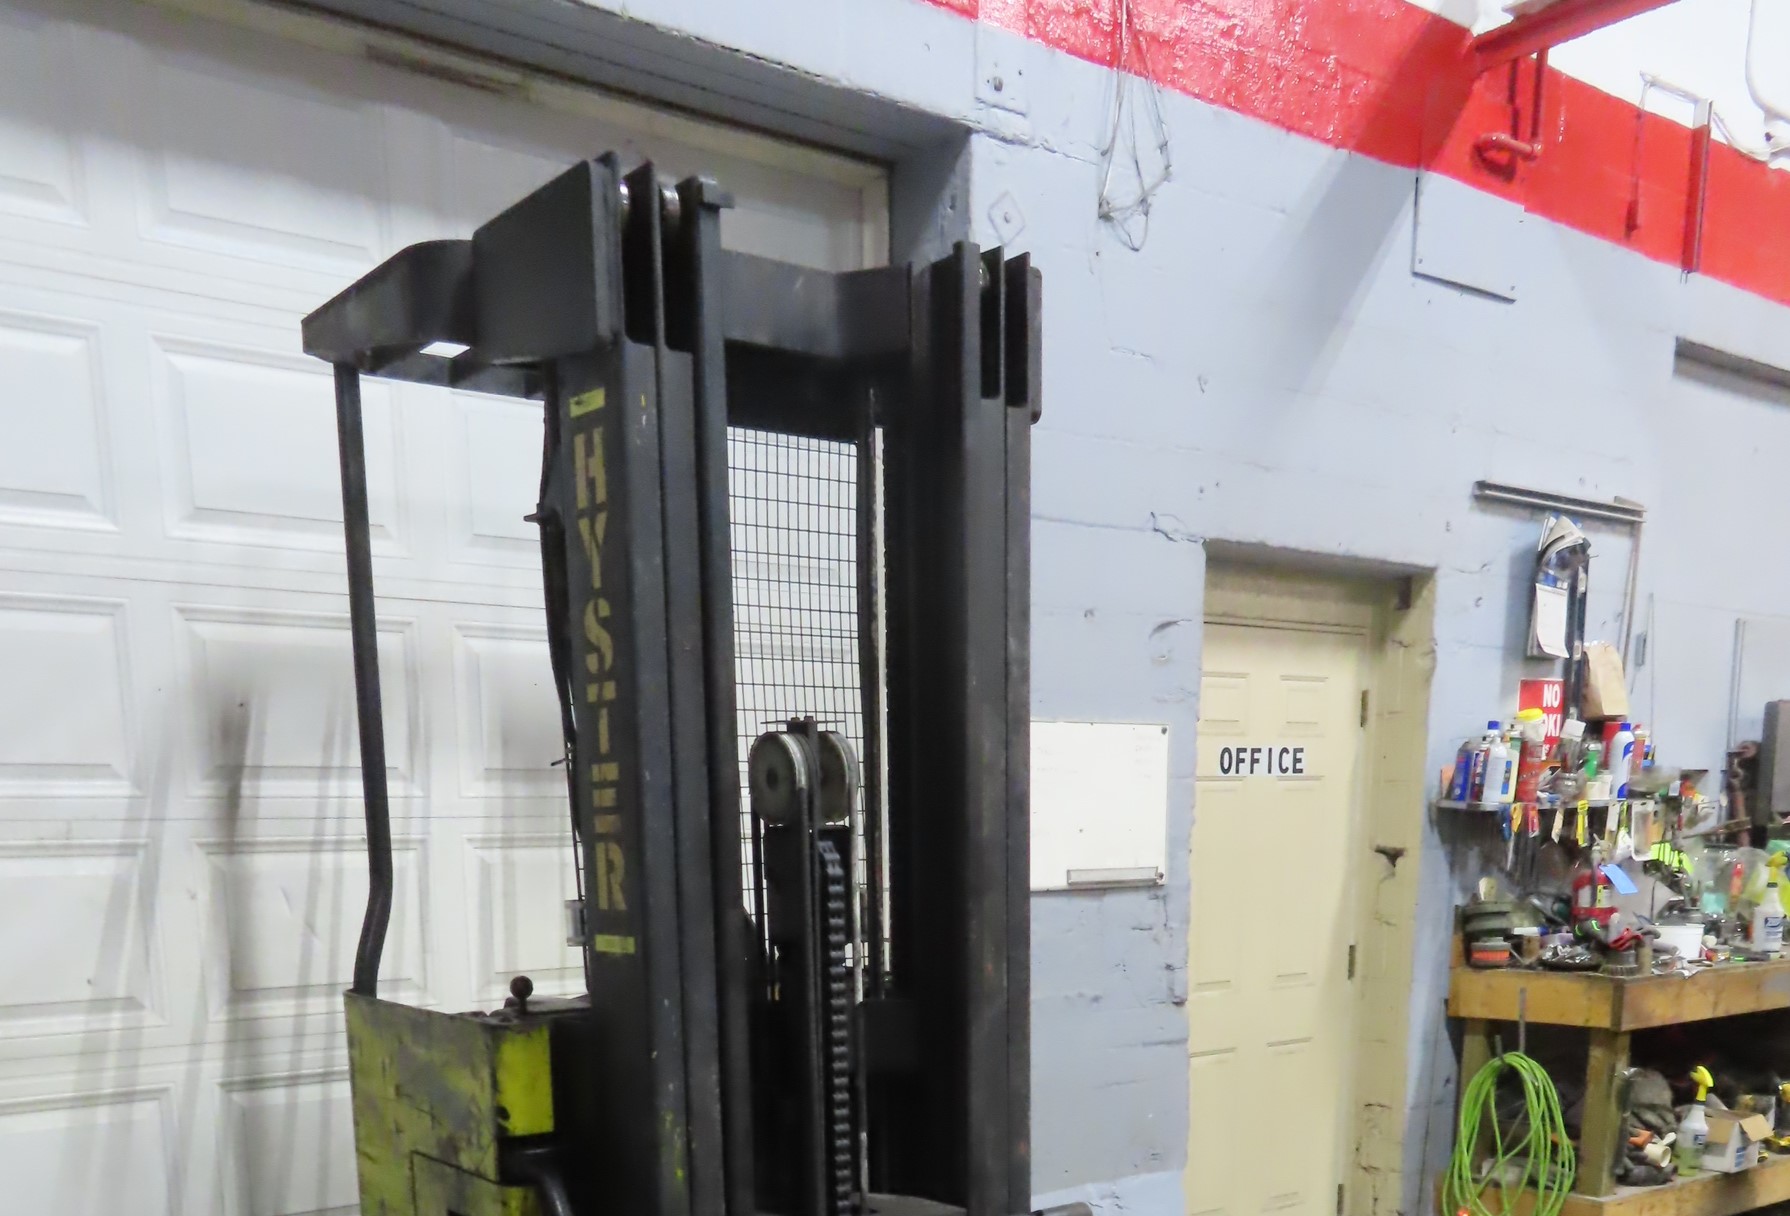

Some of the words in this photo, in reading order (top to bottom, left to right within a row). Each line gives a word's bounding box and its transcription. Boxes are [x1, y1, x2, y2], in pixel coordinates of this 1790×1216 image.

[573, 427, 627, 911] HYSTER
[1542, 683, 1561, 708] NO
[1219, 746, 1305, 775] OFFICE
